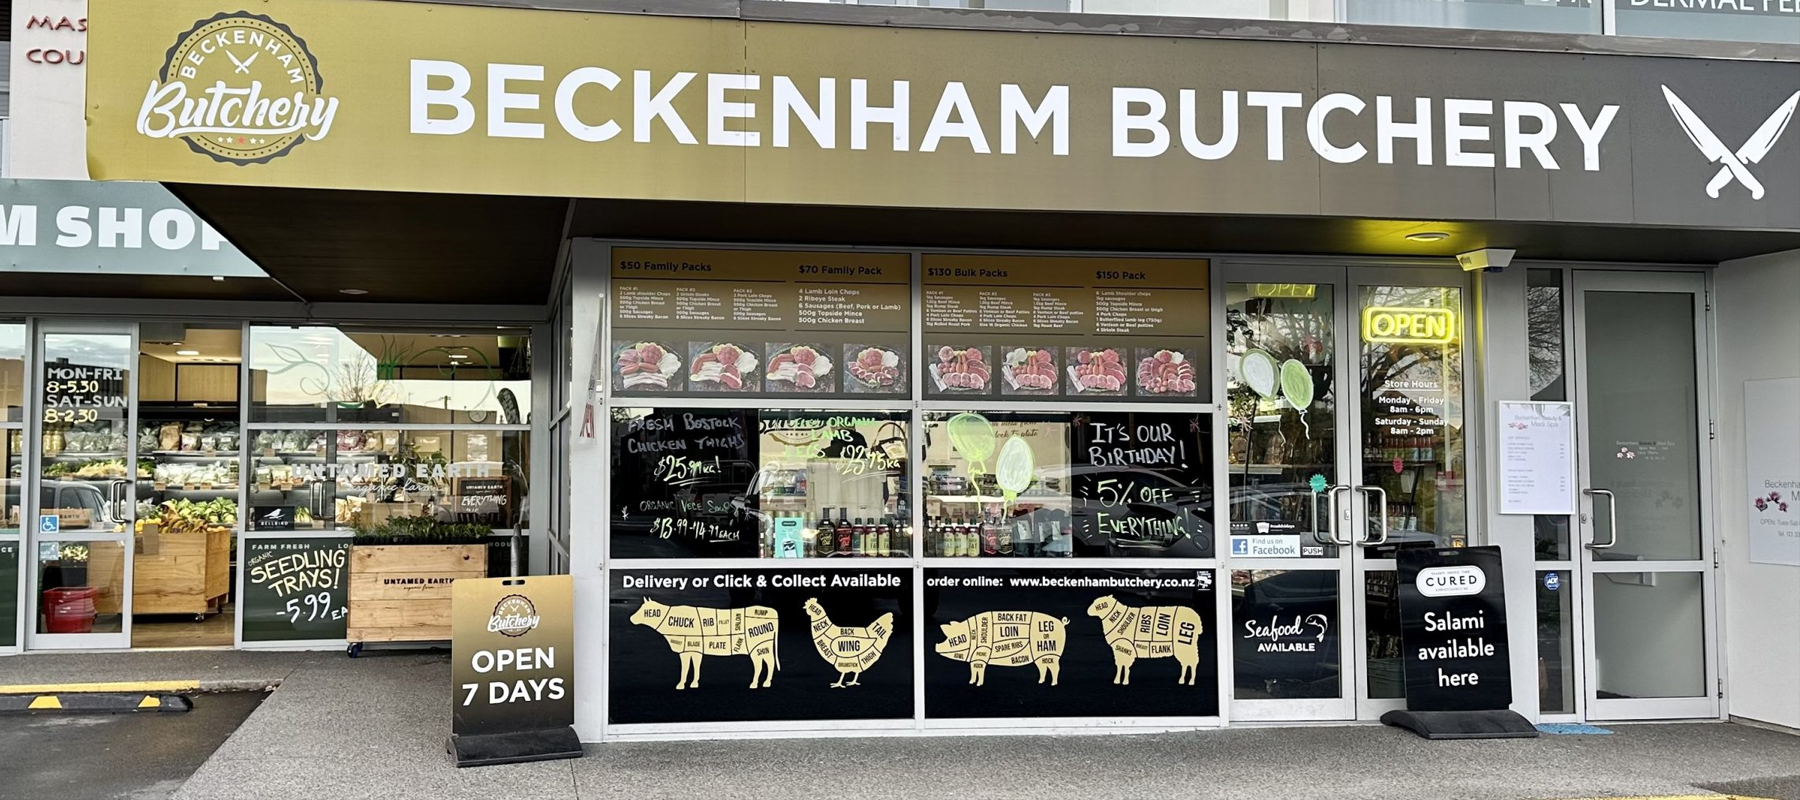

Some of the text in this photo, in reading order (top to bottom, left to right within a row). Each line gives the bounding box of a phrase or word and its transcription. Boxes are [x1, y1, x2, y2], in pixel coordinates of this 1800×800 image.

[181, 30, 304, 85] BECKENHAM
[136, 80, 339, 141] Butchery
[410, 59, 1621, 172] BECKENHAM BUTCHERY
[620, 261, 712, 272] $50 Family Packs
[799, 265, 882, 276] $70 Family Pack
[928, 267, 1008, 278] $130 Bulk Packs
[1096, 270, 1146, 281] $150 Pack
[818, 310, 843, 318] Topside
[1371, 314, 1446, 337] OPEN
[47, 367, 123, 380] MON-FRI
[46, 380, 99, 393] 8-5.30
[1384, 380, 1438, 388] Store Hours
[46, 394, 128, 408] SAT-SUN
[1379, 397, 1444, 405] Monday Friday
[1415, 406, 1434, 414] 6pm
[627, 417, 675, 433] FRESH
[1375, 418, 1449, 426] Saturday Sunday
[811, 429, 854, 442] LAMB
[1089, 422, 1176, 444] IT'S OUR
[1416, 427, 1434, 435] 2pm
[627, 433, 745, 454] CHICKEN THIGHS
[1088, 440, 1189, 469] BIRTHDAY!
[291, 463, 490, 479] UNTAMED EARTH
[1097, 478, 1173, 508] 5% OFF
[461, 494, 507, 507] EVERYTHING
[1097, 507, 1191, 540] EVERYTHING!
[1252, 545, 1296, 555] Facebook
[1302, 547, 1323, 555] PUSH
[250, 549, 346, 584] SEEDLING
[267, 568, 341, 598] TRAYS!
[622, 573, 901, 590] Delivery or Click & Collect Available
[926, 576, 960, 587] order
[963, 576, 1003, 587] online:
[1010, 576, 1196, 590] www.beckenhambutchery.co.nz
[1425, 575, 1477, 587] CURED
[643, 608, 661, 618] HEAD
[808, 603, 822, 616] HEAD
[1095, 601, 1109, 612] HEAD
[487, 613, 540, 632] Butchery
[668, 615, 695, 628] CHUCK
[702, 617, 715, 628] RIB
[997, 613, 1027, 622] BACK FAT
[1108, 609, 1122, 624] NECK
[1117, 611, 1136, 636] SHOULDER
[1140, 613, 1152, 634] RIBS
[1424, 610, 1485, 632] Salami
[748, 621, 775, 638] ROUND
[812, 619, 830, 633] NECK
[840, 627, 855, 635] BACK
[872, 621, 887, 640] TAIL
[980, 616, 989, 644] SHOULDER
[1038, 620, 1054, 633] LEG
[1156, 612, 1171, 637] LOIN
[1243, 614, 1303, 643] Seafood
[1000, 626, 1019, 638] LOIN
[1177, 621, 1196, 646] LEG
[708, 641, 727, 650] PLATE
[837, 640, 861, 652] WING
[948, 633, 967, 648] HEAD
[994, 640, 1024, 653] SPARE RIBS
[1037, 640, 1057, 652] HAM
[1257, 642, 1316, 652] AVAILABLE
[756, 646, 770, 656] SHIN
[816, 639, 834, 659] BREAST
[1151, 644, 1172, 654] FLANK
[1418, 637, 1495, 661] available
[471, 646, 555, 674] OPEN
[861, 650, 877, 665] THIGH
[1011, 655, 1030, 665] BACON
[1438, 668, 1479, 688] here
[462, 677, 565, 707] 7 DAYS
